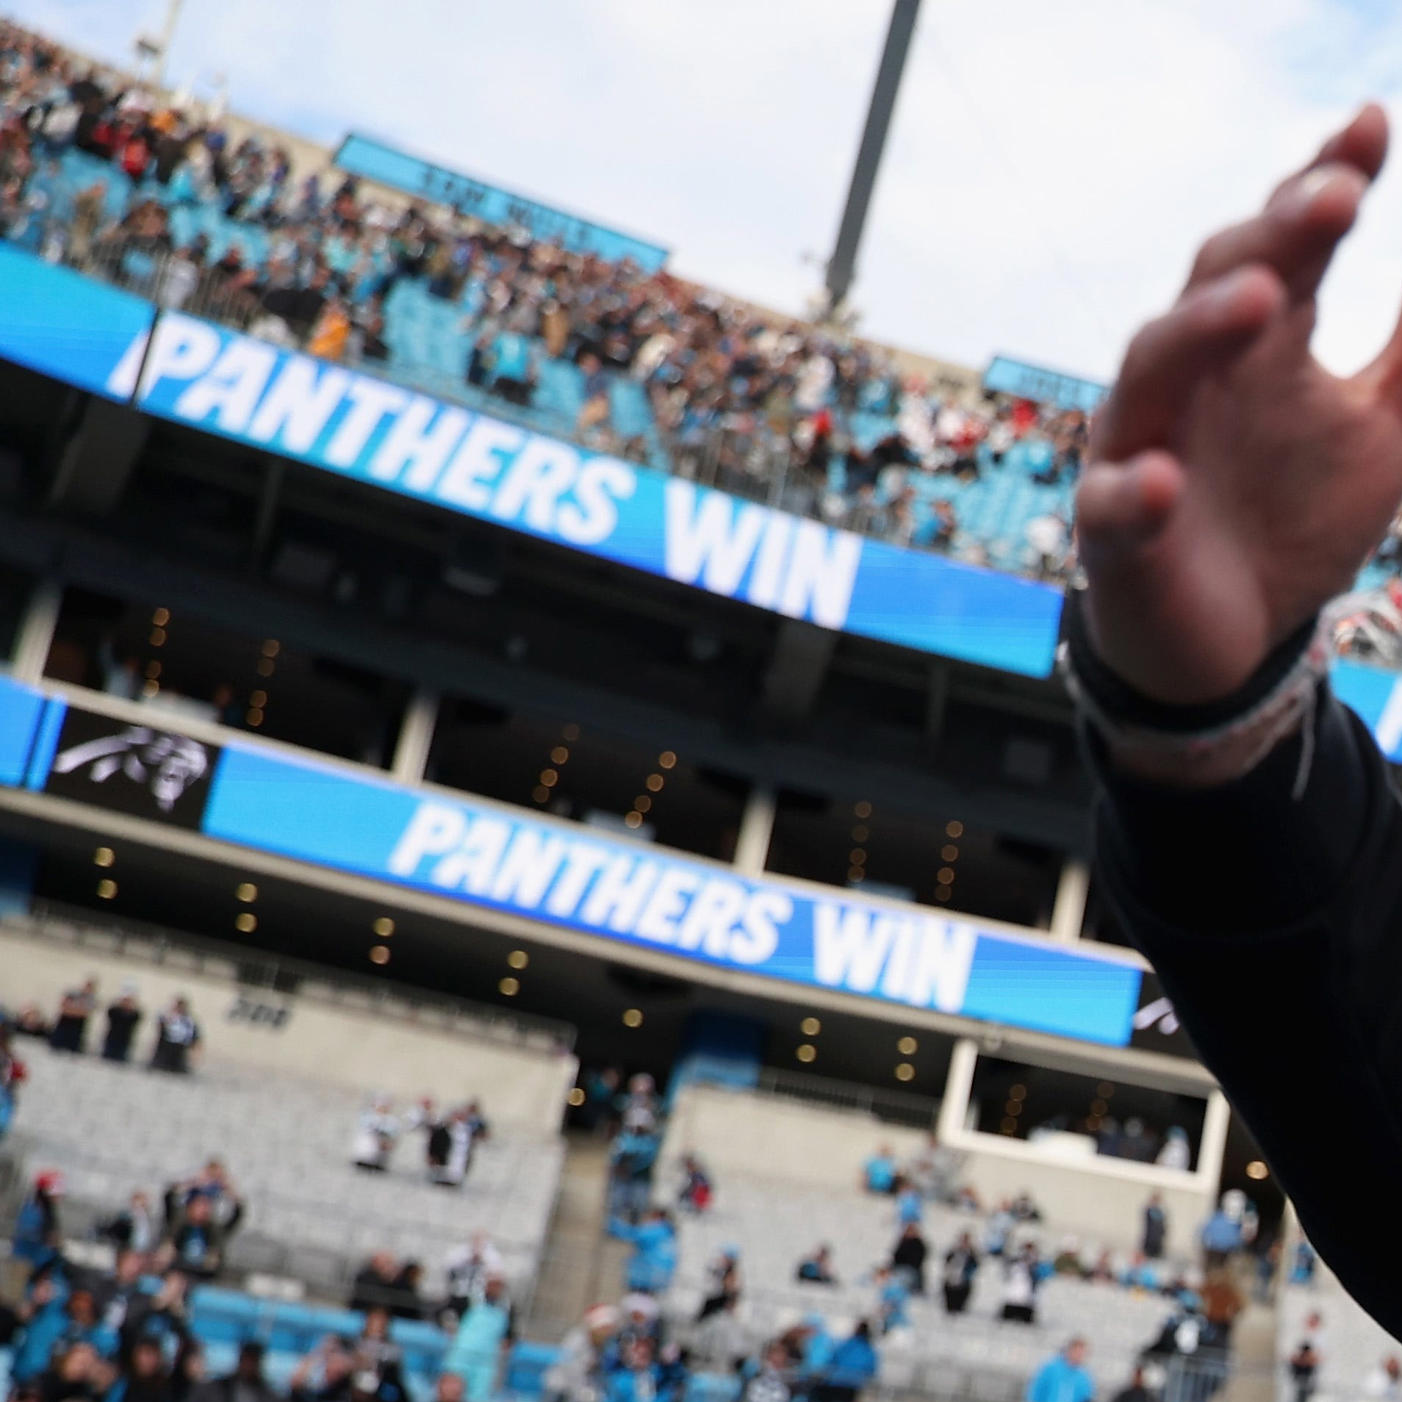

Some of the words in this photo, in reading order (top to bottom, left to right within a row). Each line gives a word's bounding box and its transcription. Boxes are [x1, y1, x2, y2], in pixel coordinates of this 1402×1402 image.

[107, 308, 637, 546] PANTHERS
[663, 479, 863, 631] WIN
[388, 799, 793, 965] PANTHERS
[810, 900, 979, 1014] WIN
